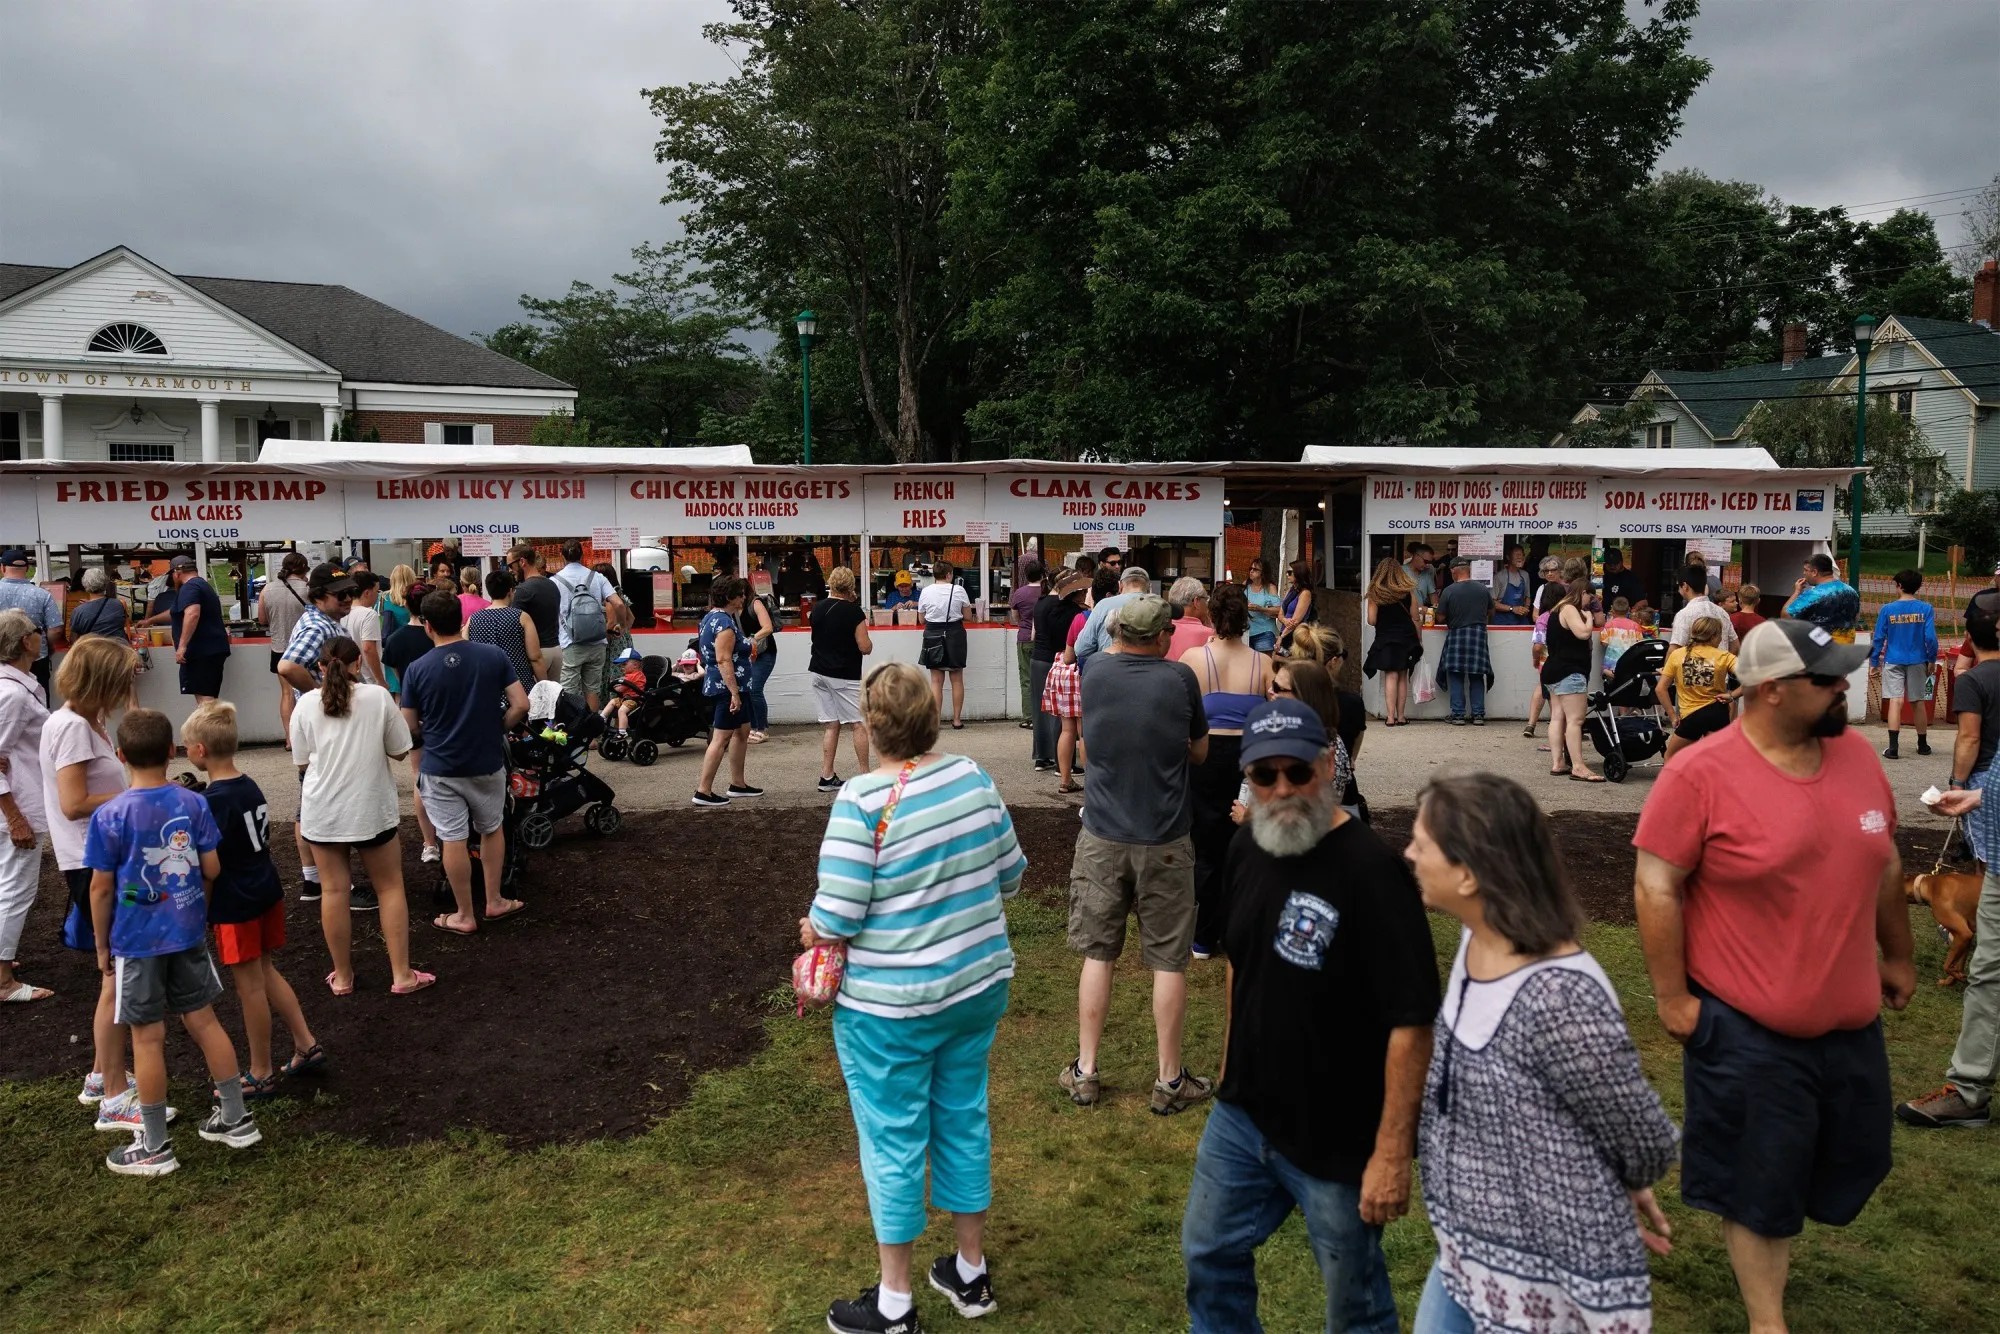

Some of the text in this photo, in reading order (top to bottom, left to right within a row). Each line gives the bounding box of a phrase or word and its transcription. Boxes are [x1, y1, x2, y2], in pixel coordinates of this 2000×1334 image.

[0, 371, 252, 392] TOWN OF YARMOUTH
[57, 480, 326, 502] FRIED SHRIMP
[377, 479, 586, 500] LEMON LUCY SLUSH
[630, 479, 850, 500] CHICKEN NUGGETS
[894, 481, 955, 501] FRENCH
[1009, 479, 1201, 501] CLAM CAKES
[1373, 480, 1588, 500] PIZZA RED HOT DOGS GRILLED CHEESE
[1605, 491, 1646, 510] SODA
[1721, 492, 1758, 511] ICED
[1763, 493, 1792, 511] TEA
[150, 505, 243, 521] CLAM CAKES
[685, 502, 799, 517] HADDOCK FINGERS
[1062, 502, 1146, 517] FRIED SHRIMP
[1429, 502, 1538, 517] KIDS VALUE MEALS
[709, 521, 775, 531] LIONS CLUB
[903, 509, 947, 529] FRIES
[1073, 521, 1135, 532] LIONS CLUB
[1388, 519, 1578, 530] SCOUTS BSA YARMOUTH TROOP #35
[158, 528, 239, 539] LIONS CLUB
[449, 524, 520, 534] LIONS CLUB
[1619, 523, 1811, 535] SCOUTS BSA YARMOUTH TROOP #35
[1889, 613, 1925, 625] BLACKWELL
